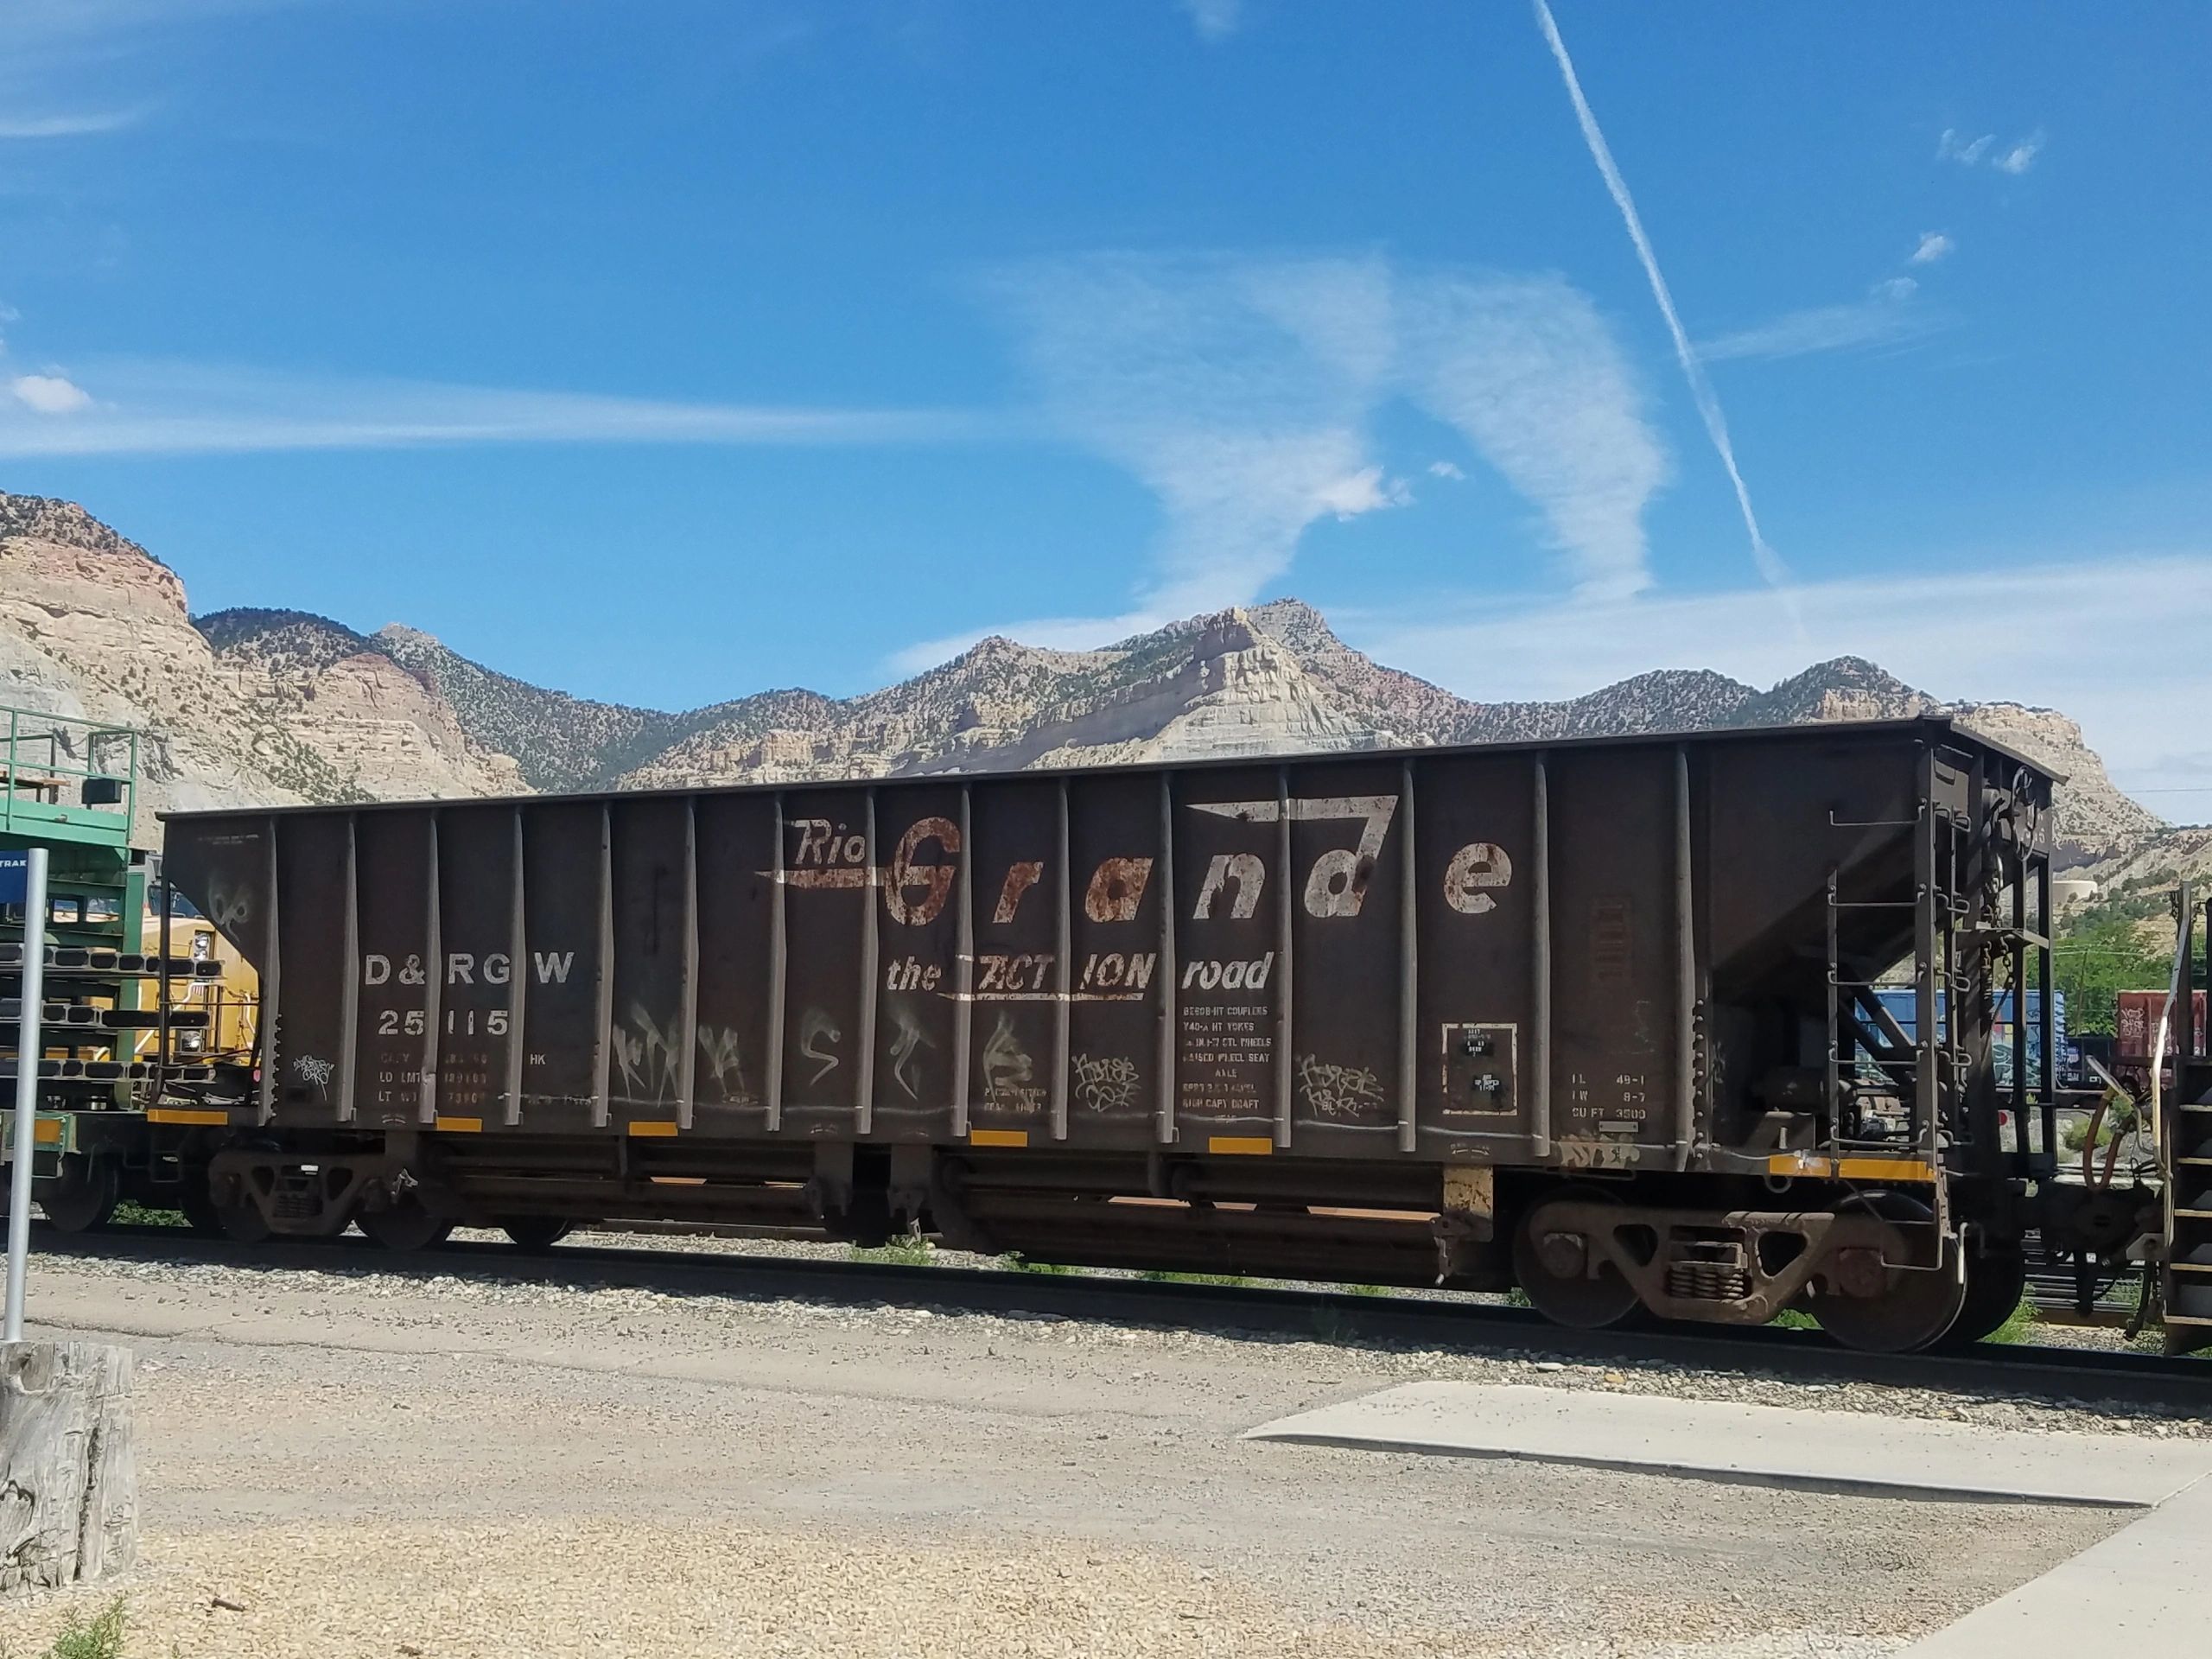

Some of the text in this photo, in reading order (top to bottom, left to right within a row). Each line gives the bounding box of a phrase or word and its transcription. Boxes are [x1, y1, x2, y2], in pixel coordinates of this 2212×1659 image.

[793, 818, 865, 864] Rio
[886, 795, 1512, 925] Grande
[887, 956, 942, 991] the
[1182, 951, 1274, 989] road
[378, 1009, 508, 1035] 25115
[530, 1053, 546, 1065] HK
[379, 1071, 393, 1084] LD
[378, 1090, 392, 1102] LT
